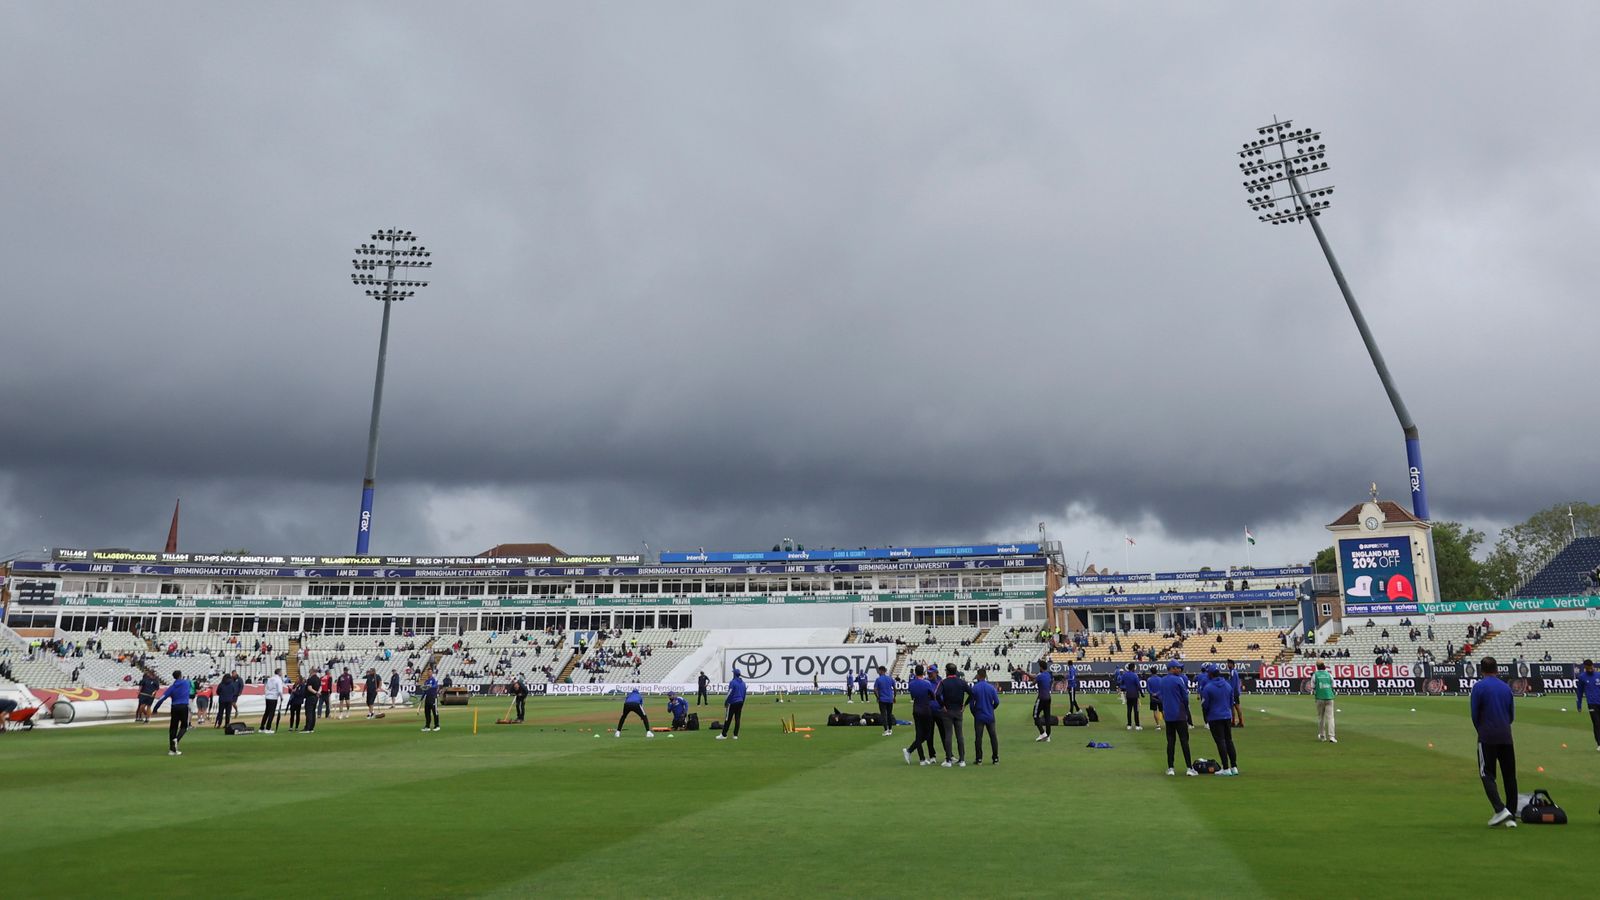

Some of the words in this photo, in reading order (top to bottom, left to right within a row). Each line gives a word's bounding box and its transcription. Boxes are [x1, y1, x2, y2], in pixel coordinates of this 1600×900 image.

[1410, 466, 1421, 492] drax
[360, 510, 370, 532] drax
[93, 552, 157, 560] VILLAGEGYM.CO.UK
[1352, 558, 1377, 568] 20%
[1379, 556, 1400, 568] OFF
[1268, 589, 1294, 597] scrivens
[1465, 602, 1494, 610] Vertu
[1509, 600, 1539, 609] Vertu
[1553, 598, 1585, 608] Vertu
[1588, 610, 1596, 618] 19
[782, 656, 878, 676] TOYOTA
[1358, 666, 1370, 676] IG
[1396, 666, 1409, 676] IG
[1263, 666, 1276, 678] IG
[1282, 666, 1294, 677] IG
[1338, 666, 1351, 677] IG
[1377, 666, 1390, 677] IG
[552, 684, 604, 693] Rothesay
[1080, 680, 1110, 688] RADO
[1256, 680, 1290, 688] RADO
[1332, 679, 1370, 688] RADO
[1378, 679, 1415, 688] RADO
